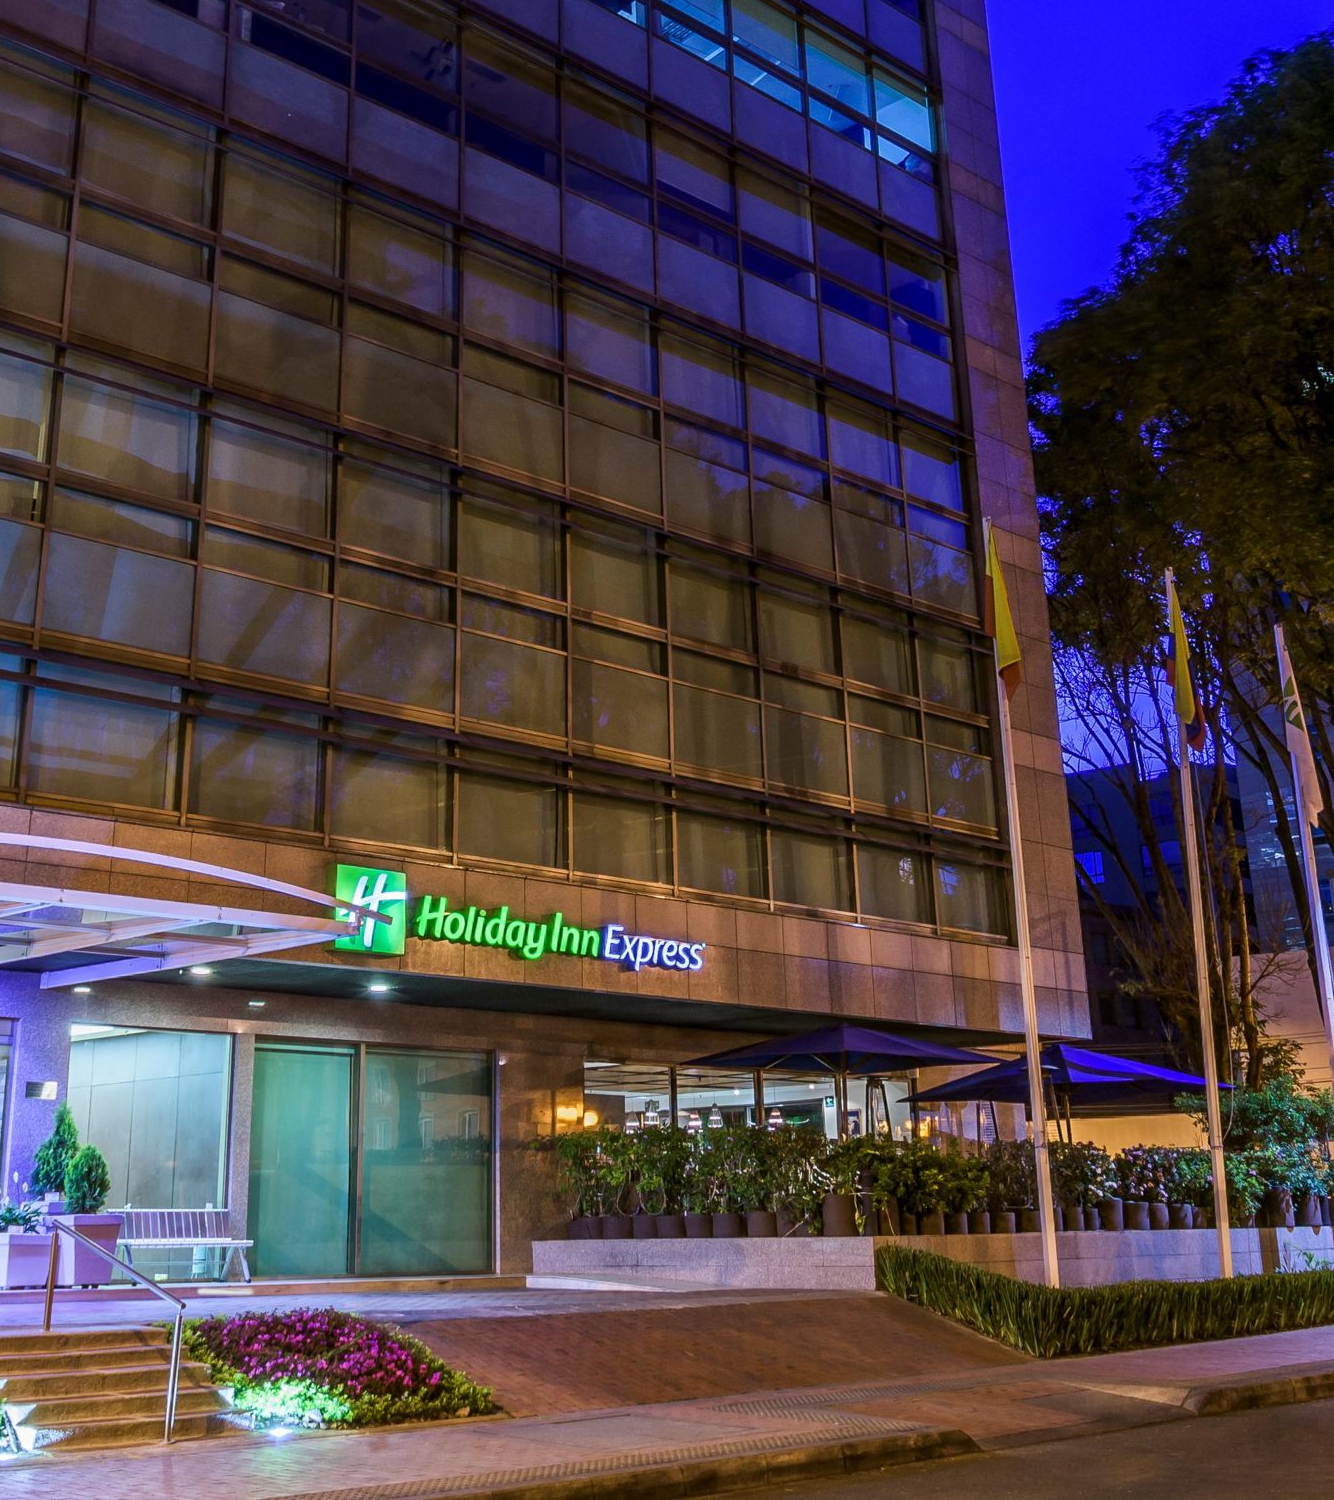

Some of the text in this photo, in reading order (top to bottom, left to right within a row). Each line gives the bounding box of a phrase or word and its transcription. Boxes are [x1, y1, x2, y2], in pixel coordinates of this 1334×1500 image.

[417, 895, 704, 971] Holiday Inn Express
